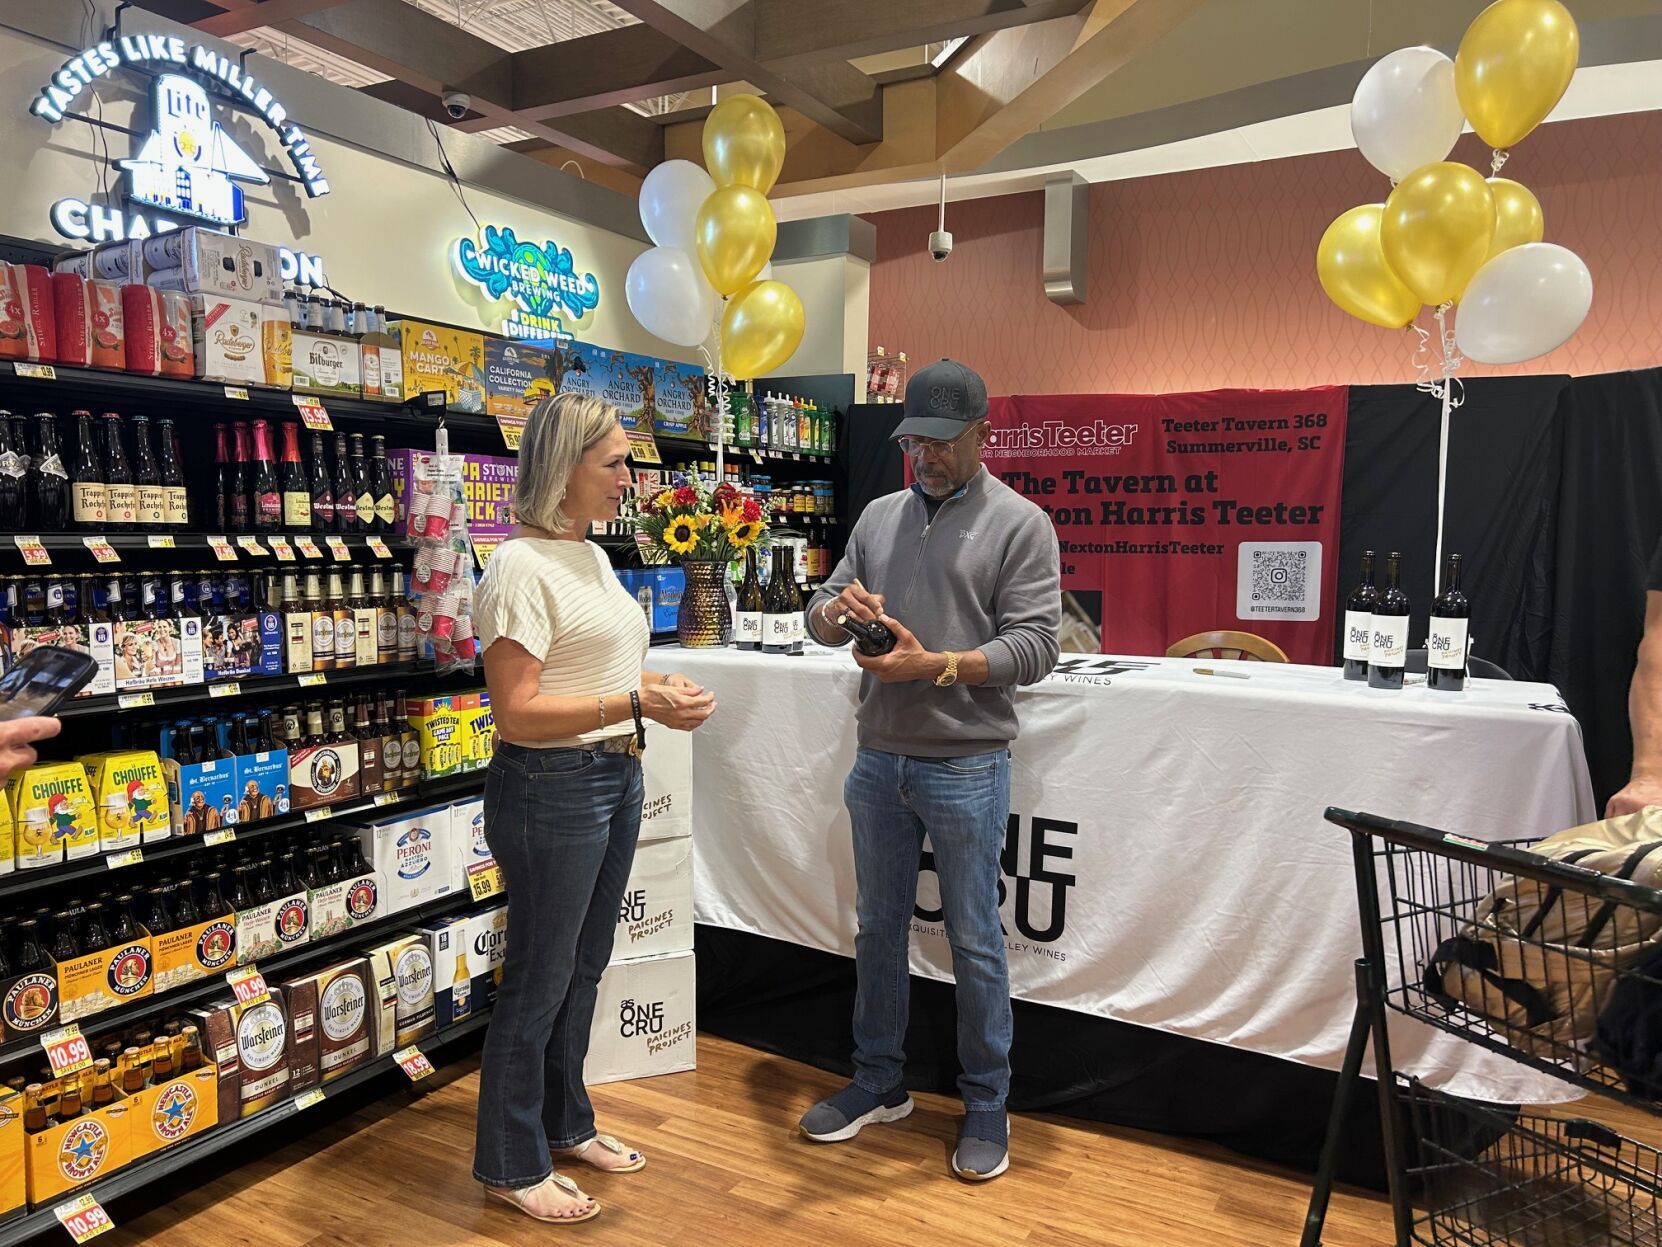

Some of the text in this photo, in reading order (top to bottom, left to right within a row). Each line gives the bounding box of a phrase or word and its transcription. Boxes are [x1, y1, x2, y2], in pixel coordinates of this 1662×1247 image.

[35, 35, 330, 197] TASTES LIKE MILLER TIME
[474, 250, 586, 296] WICKED WEED
[511, 281, 561, 301] BREWING
[521, 311, 561, 332] DRINK
[162, 328, 174, 337] 4x
[309, 352, 343, 369] Bitburger
[410, 351, 450, 366] MANGO
[416, 363, 444, 376] CART
[489, 365, 532, 379] CALIFORNIA
[489, 375, 533, 391] COLLECTION
[566, 377, 590, 388] ANGRY
[608, 380, 635, 391] ANGRY
[602, 389, 641, 404] ORCHARD
[662, 389, 686, 399] ANGRY
[931, 386, 961, 399] ONE
[657, 398, 692, 411] ORCHARD
[301, 407, 329, 425] 15.99
[1162, 413, 1327, 433] Teeter Tavern 368
[995, 447, 1075, 459] NEIGHBORHOOD
[1077, 446, 1122, 456] MARKET
[1166, 436, 1321, 454] Summerville, SC
[1001, 470, 1218, 495] The Tavern at
[1100, 500, 1324, 526] Harris Teeter
[25, 550, 46, 561] 5.99
[93, 548, 115, 558] 5.99
[1250, 605, 1306, 613] @TEETERTAVERN368
[1350, 636, 1369, 644] CRU
[1374, 634, 1394, 642] ONE
[1374, 640, 1393, 649] CRU
[1432, 642, 1450, 651] CRU
[1064, 675, 1112, 686] WINES
[425, 717, 459, 730] TWISTED TEA
[113, 765, 158, 786] CHOUFFE
[253, 762, 283, 774] Bernardus
[199, 772, 229, 783] Bernardus
[32, 778, 84, 801] CHOUFFE
[396, 841, 432, 860] PERONI
[400, 856, 428, 869] AZZURRO
[315, 887, 343, 900] PAULANER
[347, 878, 378, 899] PAULANER
[473, 879, 492, 896] 15.99
[622, 889, 646, 908] NE
[241, 908, 272, 922] PAULANER
[276, 899, 308, 920] PAULANER
[350, 904, 376, 920] MÜNCHEN
[628, 909, 673, 936] PAICINES
[630, 918, 674, 944] PROJECT
[158, 931, 193, 947] PAULANER
[198, 921, 235, 945] PAULANER
[279, 926, 307, 942] MÜNCHEN
[110, 945, 151, 971] PAULANER
[201, 949, 233, 968] MÜNCHEN
[1033, 945, 1066, 962] WINES
[64, 957, 103, 974] PAULANER
[113, 975, 148, 995] MÜNCHEN
[399, 966, 431, 989] Warsteiner
[7, 975, 56, 1002] PAULANER
[236, 977, 266, 1002] 10.99
[324, 995, 364, 1021] Warsteiner
[620, 998, 634, 1009] as
[620, 1001, 664, 1023] ONE
[12, 1007, 53, 1028] MÜNCHEN
[64, 1025, 78, 1036] 12.99
[620, 1016, 663, 1038] CRU
[646, 1021, 692, 1048] PAICINES
[241, 1023, 284, 1051] Warsteiner
[648, 1030, 692, 1056] PROJECT
[51, 1041, 89, 1067] 10.99
[333, 1047, 357, 1061] DUNKEL
[60, 1062, 86, 1075] SAVE 2.00
[404, 1056, 430, 1077] 18.99
[254, 1076, 279, 1090] DUNKEL
[158, 1084, 192, 1111] NEWCASTLE
[158, 1111, 193, 1138] BROWN ALE
[64, 1121, 103, 1151] NEWCASTLE
[65, 1146, 104, 1178] BROWN ALE
[79, 1195, 93, 1206] 12.99
[68, 1207, 107, 1237] 10.99
